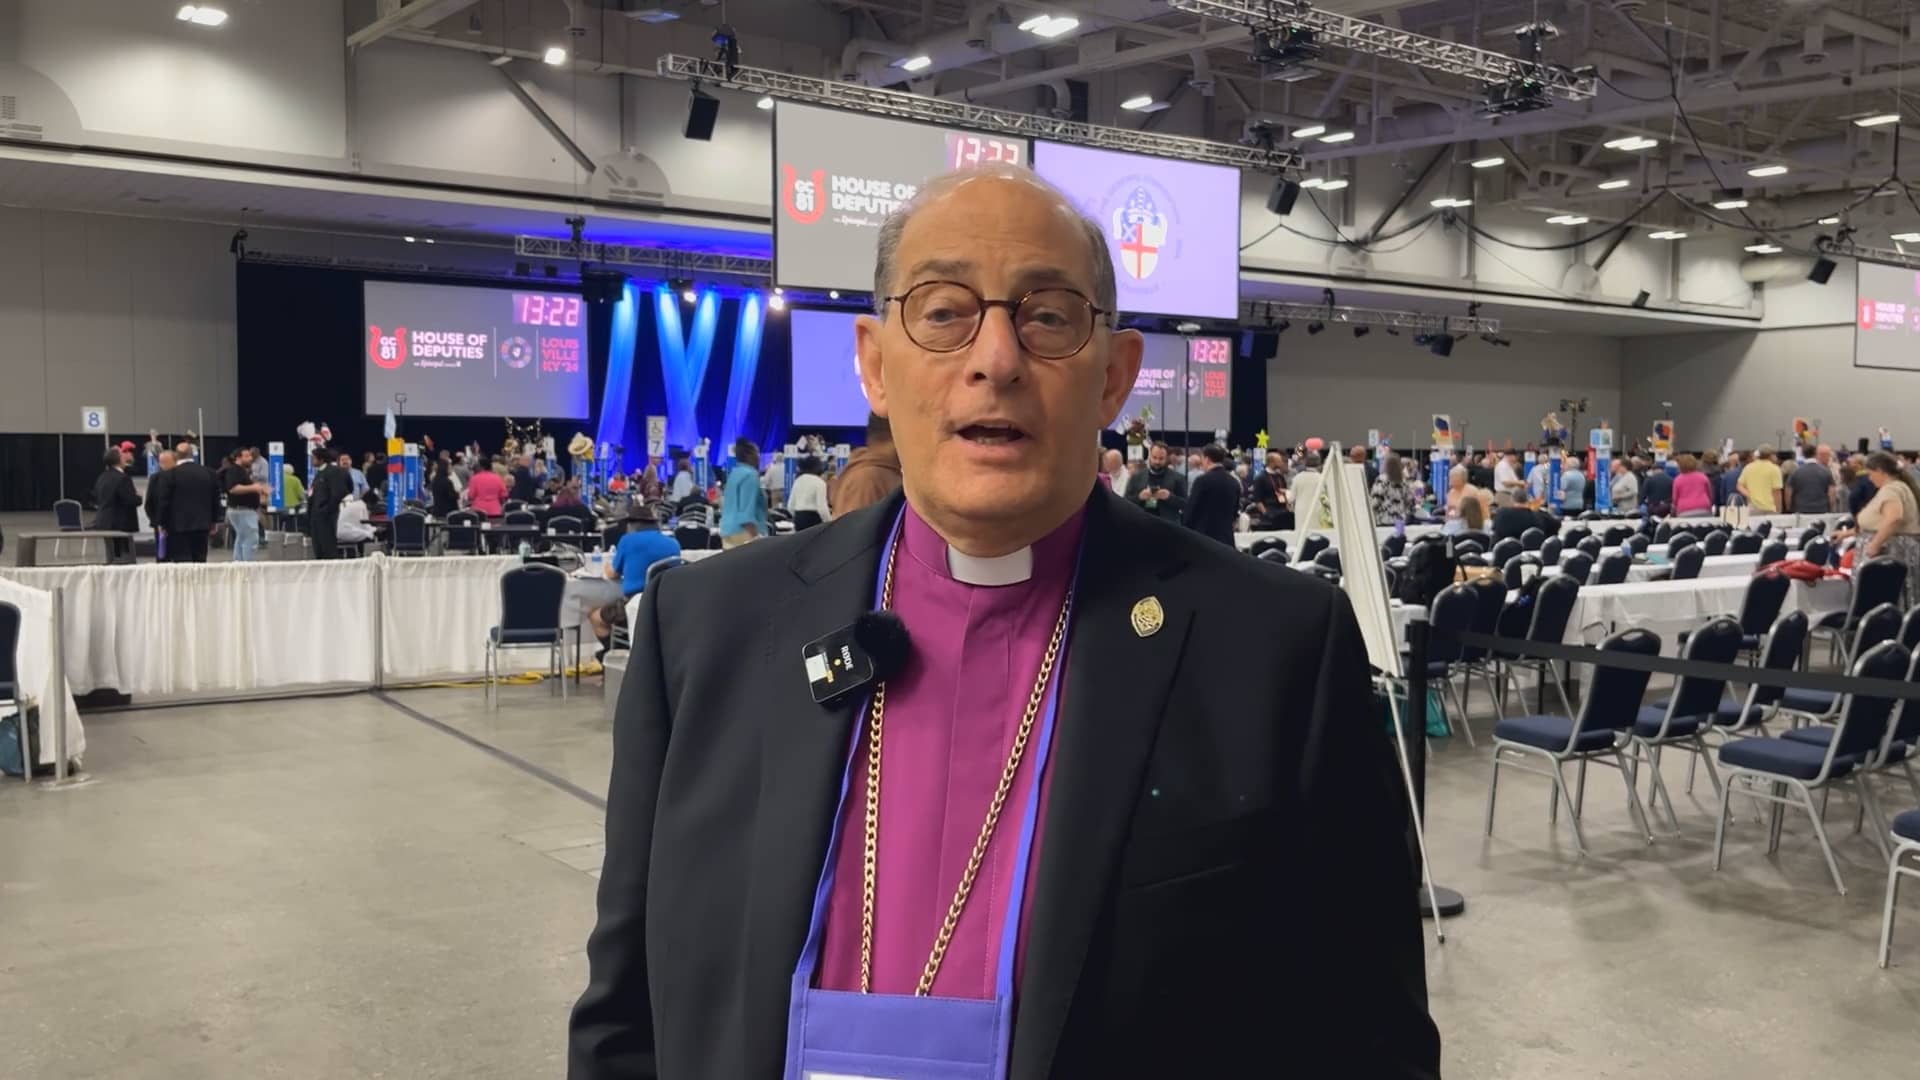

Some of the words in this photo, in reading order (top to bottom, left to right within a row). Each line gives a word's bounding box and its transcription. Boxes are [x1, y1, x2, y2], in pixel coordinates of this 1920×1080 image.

[832, 175, 891, 198] HOUSE
[893, 184, 917, 200] OF
[832, 193, 904, 215] DEPUTI
[521, 296, 580, 326] 13:22
[380, 336, 397, 346] GC
[412, 331, 464, 346] HOUSE
[467, 334, 488, 346] OF
[381, 345, 396, 359] 81
[412, 344, 484, 359] DEPUTIES
[88, 411, 100, 428] 8
[653, 440, 660, 454] 7
